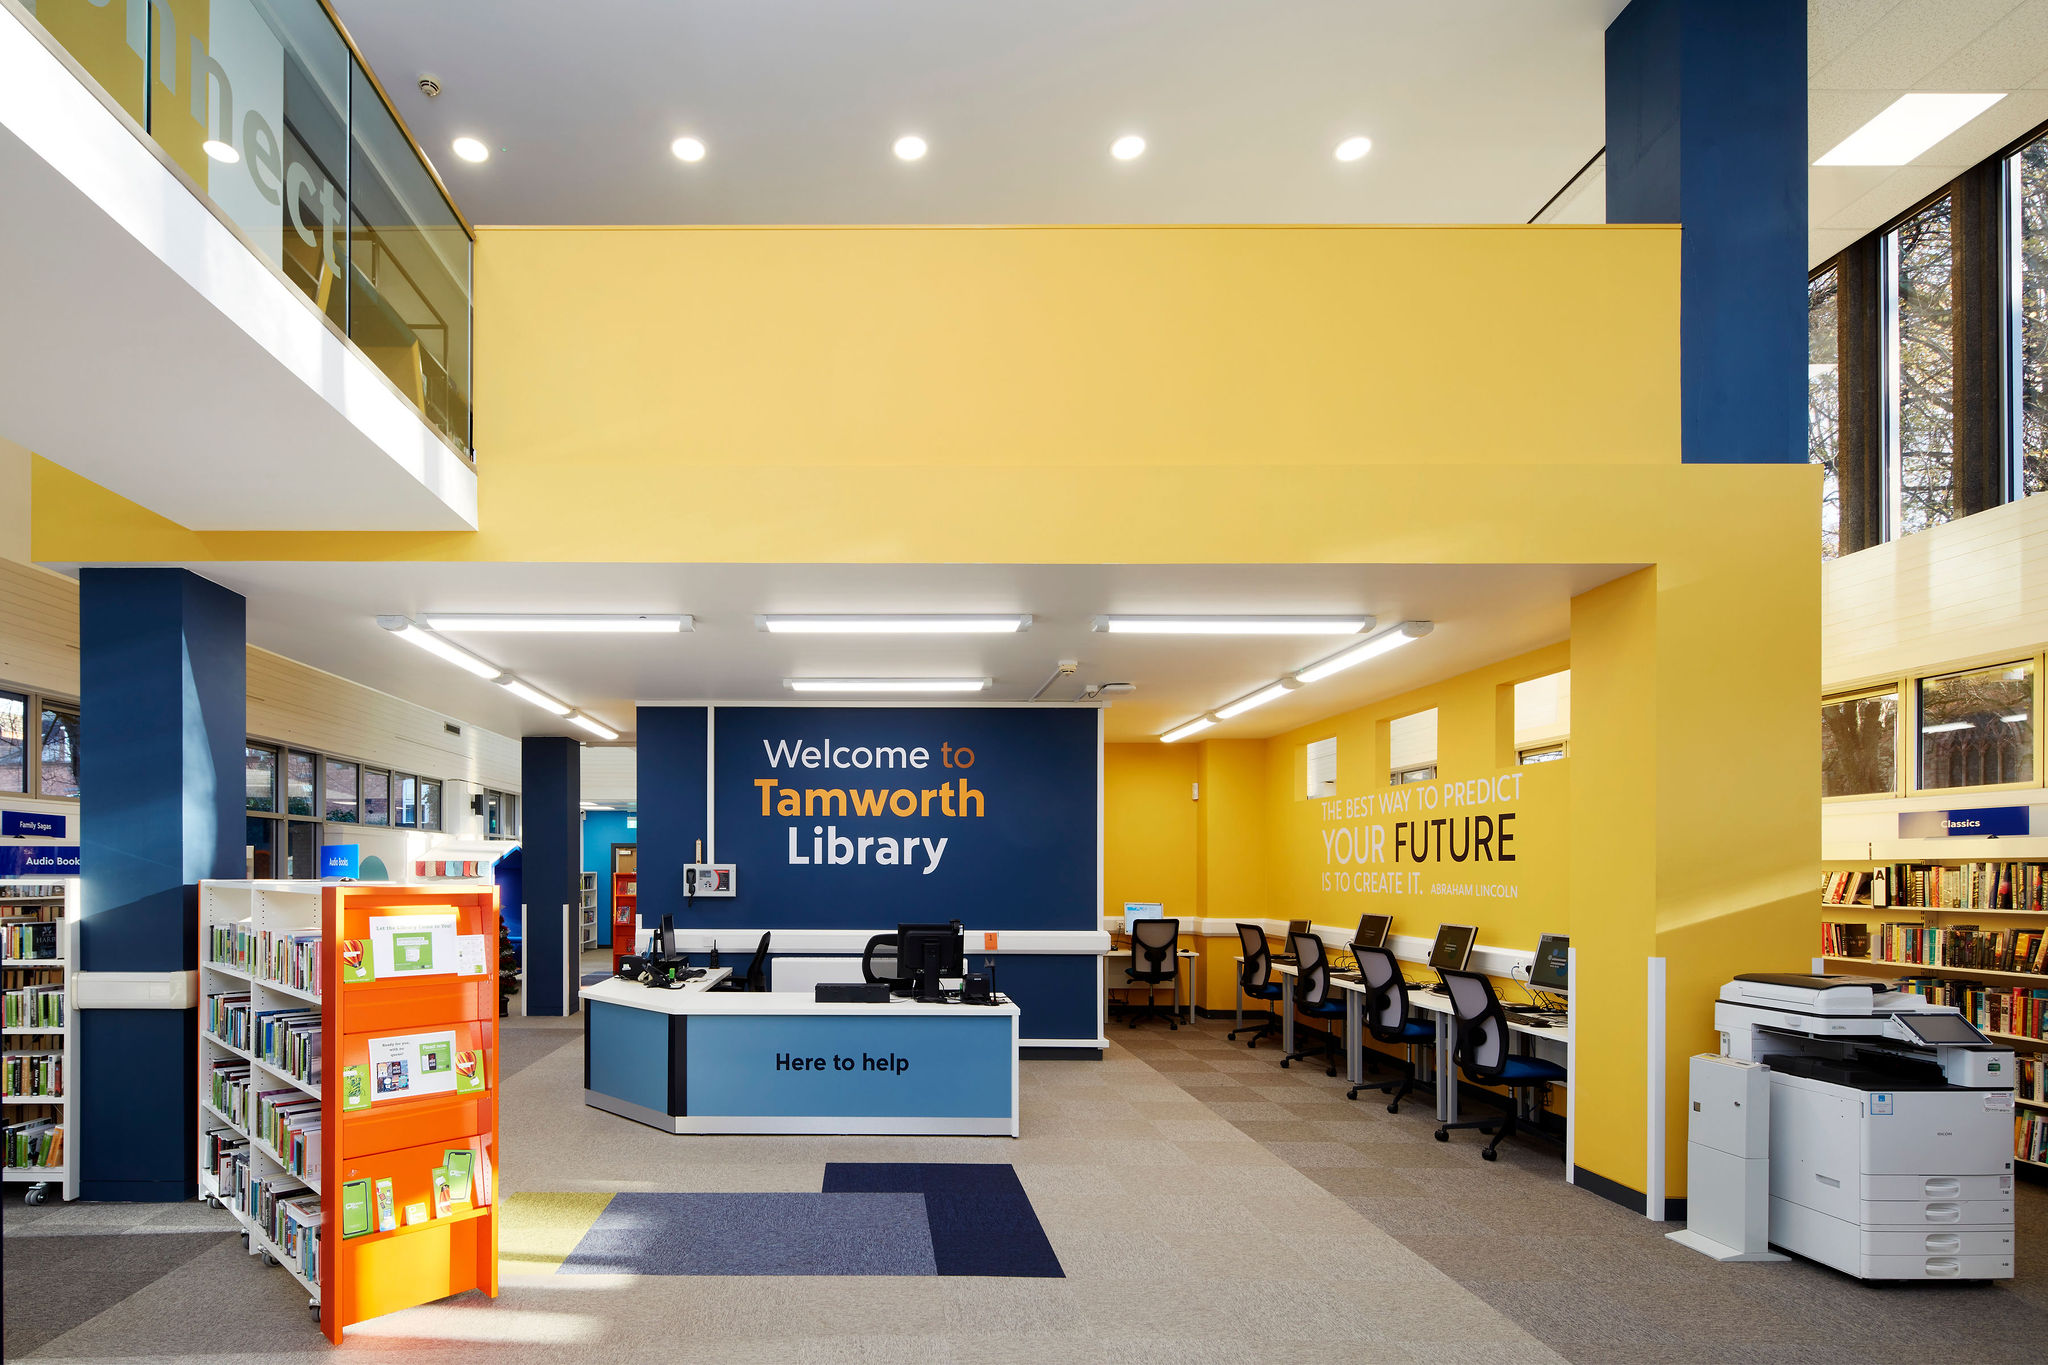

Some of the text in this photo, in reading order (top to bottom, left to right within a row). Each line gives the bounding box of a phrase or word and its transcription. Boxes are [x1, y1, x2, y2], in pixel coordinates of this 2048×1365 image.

[763, 739, 975, 769] Welcome to
[754, 778, 985, 818] Tamworth
[1321, 773, 1523, 821] THE BEST WAY TO PREDICT
[20, 821, 52, 831] Family Sagas
[1940, 819, 1981, 829] Classics
[789, 826, 949, 875] Library
[1322, 813, 1516, 865] YOUR FUTURE
[25, 856, 54, 866] Audio
[1321, 872, 1423, 895] IS TO CREATE IT.
[1875, 870, 1885, 881] A
[1430, 883, 1519, 898] ABRAHAM LINCOLN
[776, 1052, 910, 1076] Here to help
